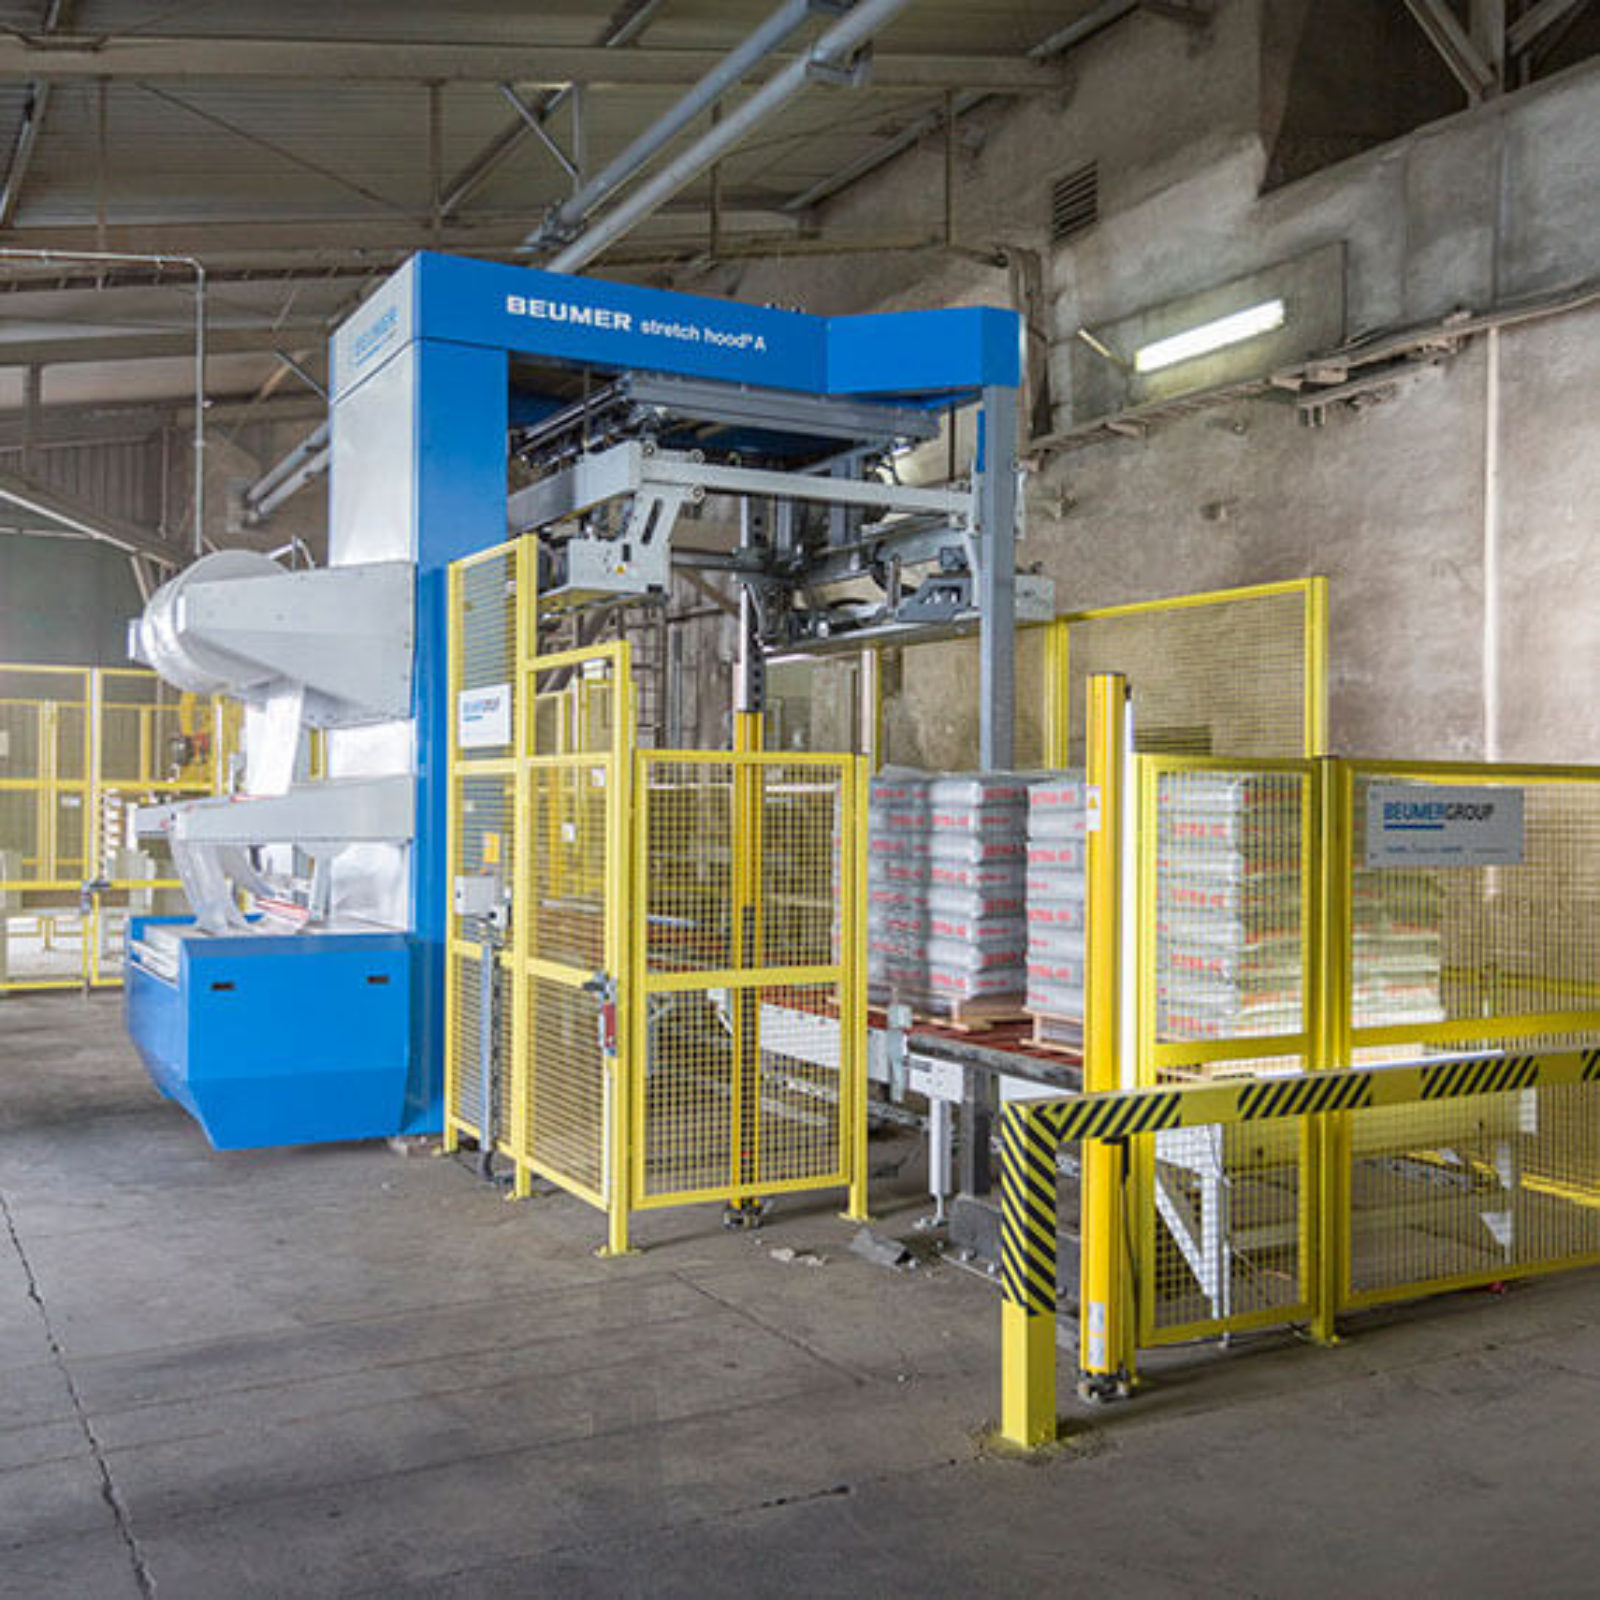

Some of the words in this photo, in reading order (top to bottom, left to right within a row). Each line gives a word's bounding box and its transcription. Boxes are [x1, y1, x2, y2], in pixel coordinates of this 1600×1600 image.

[506, 294, 633, 332] BEUMER
[640, 319, 700, 342] stretch
[754, 336, 767, 352] A
